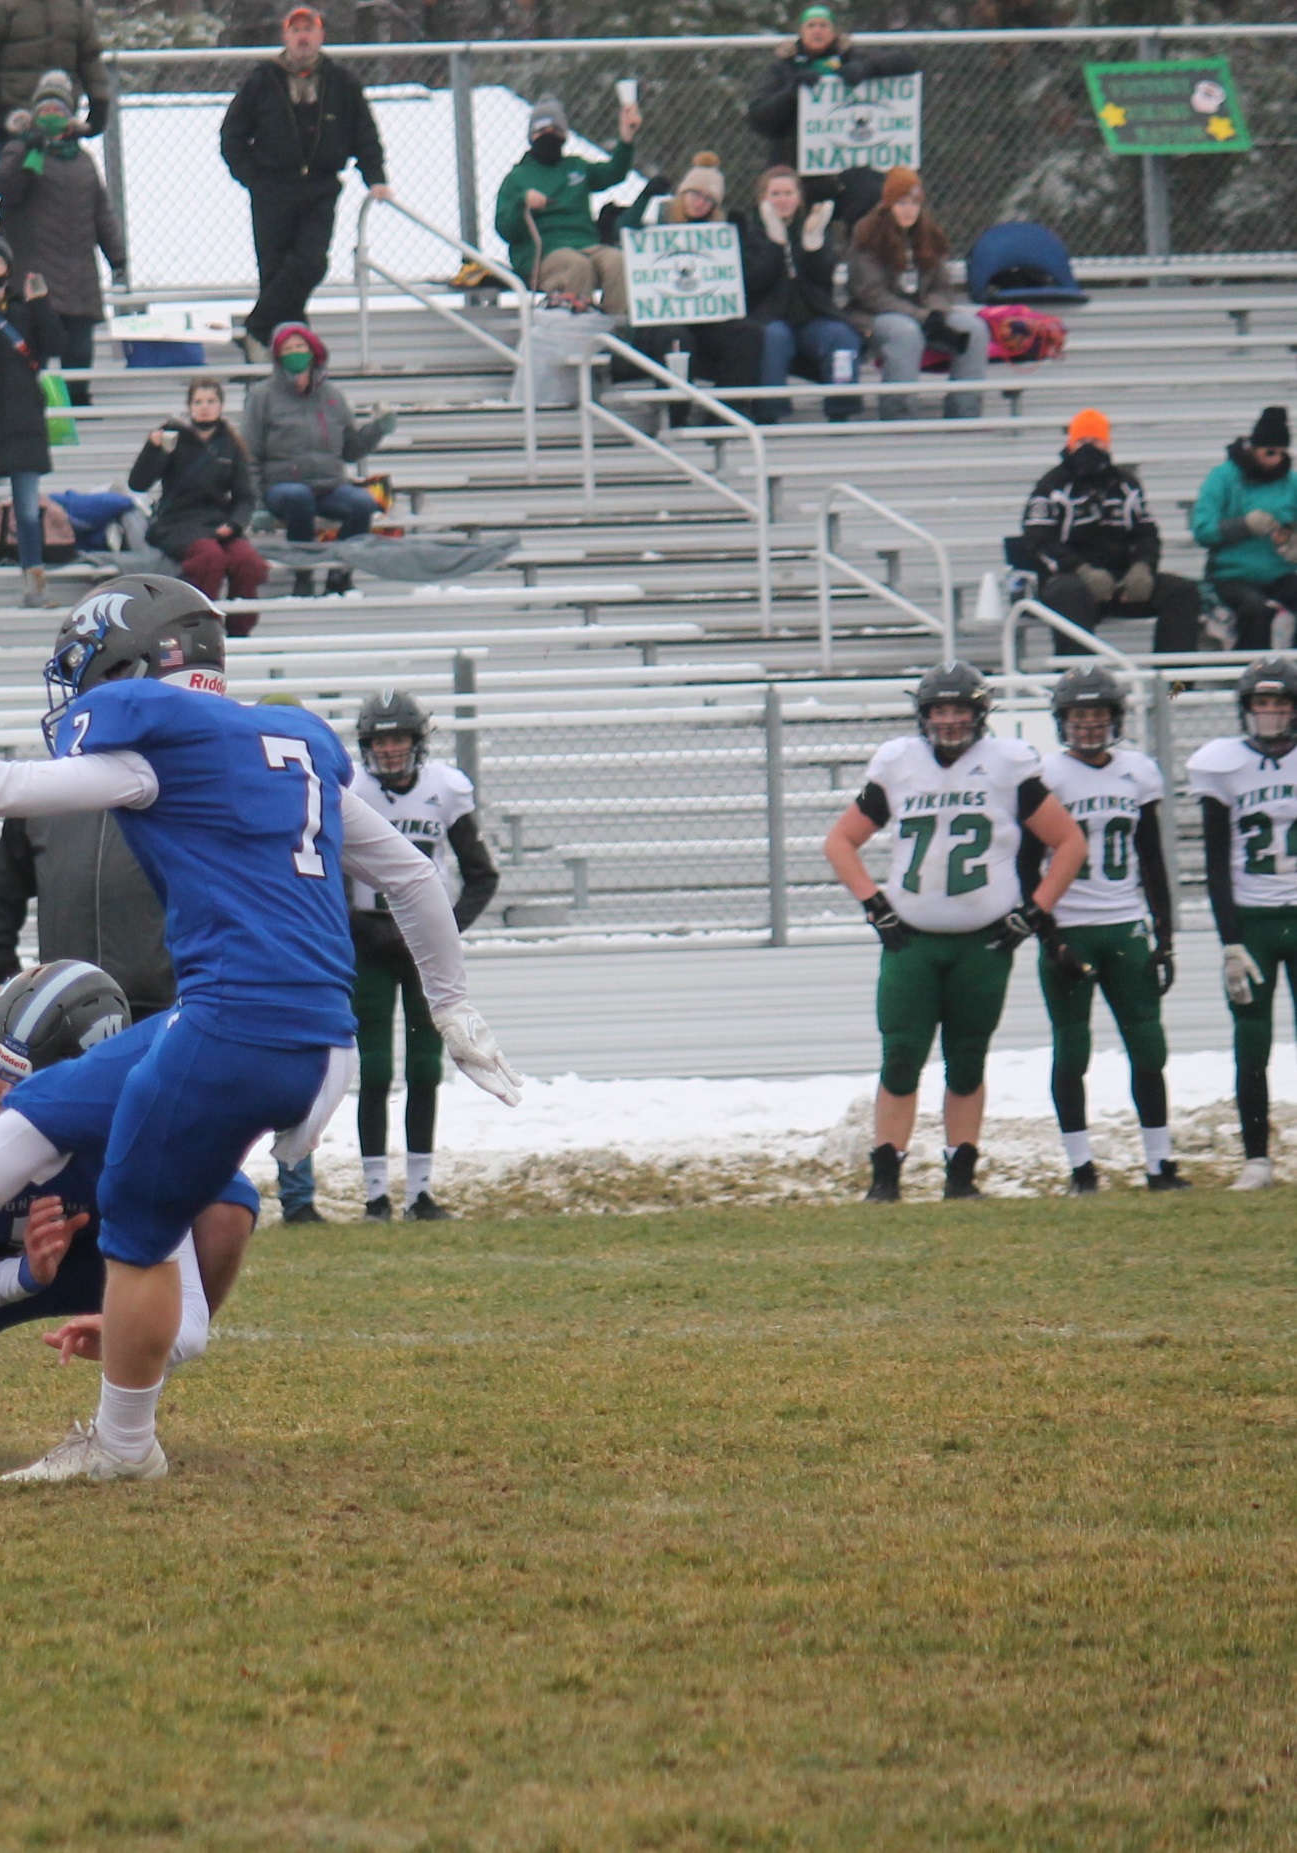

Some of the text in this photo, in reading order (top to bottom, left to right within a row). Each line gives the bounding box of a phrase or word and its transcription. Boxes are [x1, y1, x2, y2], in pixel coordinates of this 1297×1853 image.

[809, 79, 915, 104] VIKING
[806, 144, 912, 169] NATION
[630, 228, 733, 254] VIKING
[636, 294, 738, 319] NATION
[69, 710, 92, 756] 7
[260, 734, 327, 879] 7
[904, 791, 988, 812] VIKINGS
[1064, 795, 1137, 814] VIKINGS
[1238, 785, 1294, 810] VIKIN
[390, 819, 441, 837] INGS
[900, 812, 993, 896] 72
